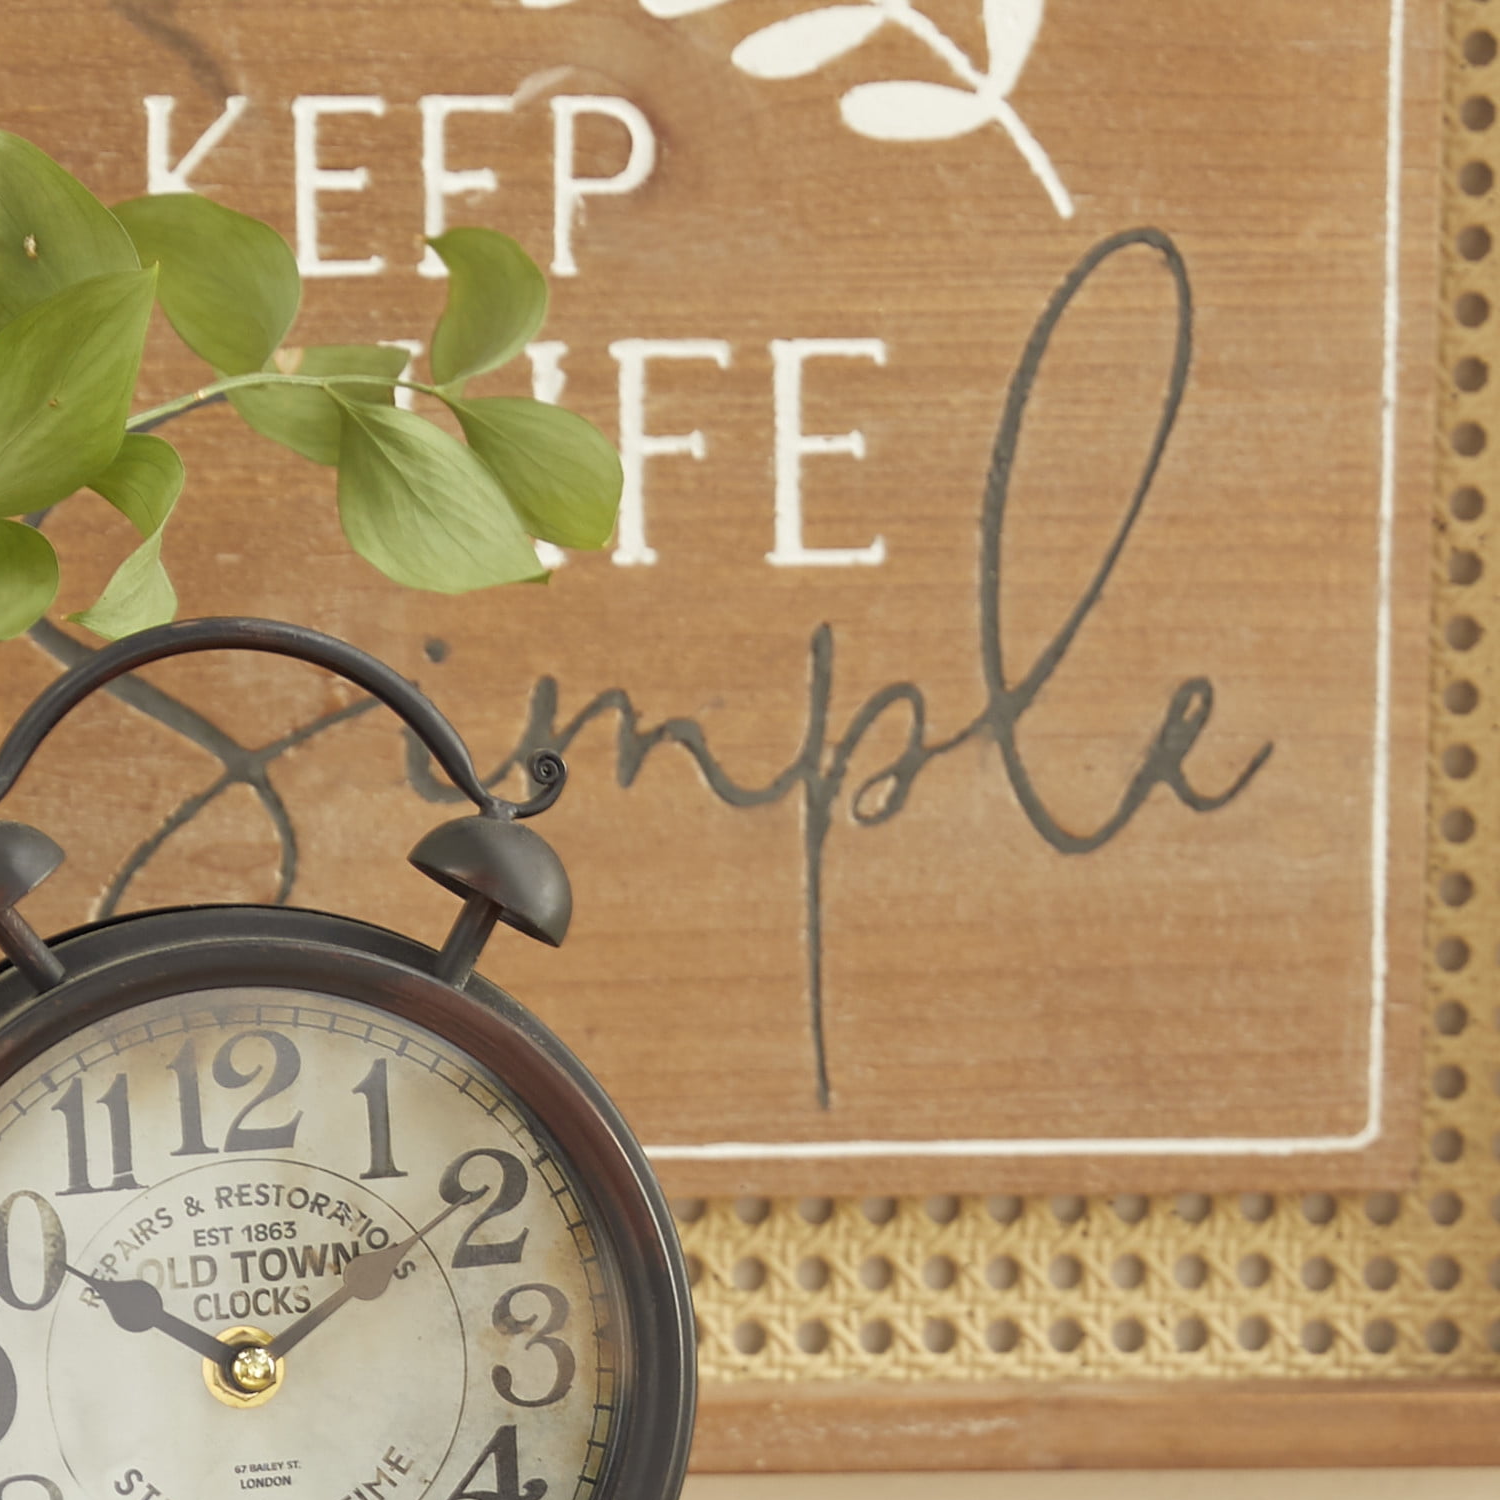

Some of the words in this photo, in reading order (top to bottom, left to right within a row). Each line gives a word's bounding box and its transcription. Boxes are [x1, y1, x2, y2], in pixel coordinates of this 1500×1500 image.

[51, 1074, 148, 1196] 11
[167, 1030, 303, 1157] 12
[352, 1059, 407, 1180] 1
[184, 1196, 205, 1217] &
[215, 1183, 416, 1281] RESTORATIOS
[193, 1227, 233, 1247] EST
[241, 1221, 297, 1243] 1863
[439, 1149, 529, 1268] 2
[136, 1254, 218, 1290] OLD
[231, 1241, 361, 1283] TOWN
[193, 1285, 311, 1322] CLOCKS
[492, 1284, 575, 1406] 3
[234, 1465, 247, 1474] 67
[249, 1462, 284, 1473] BAILEY
[240, 1475, 292, 1489] LONDON
